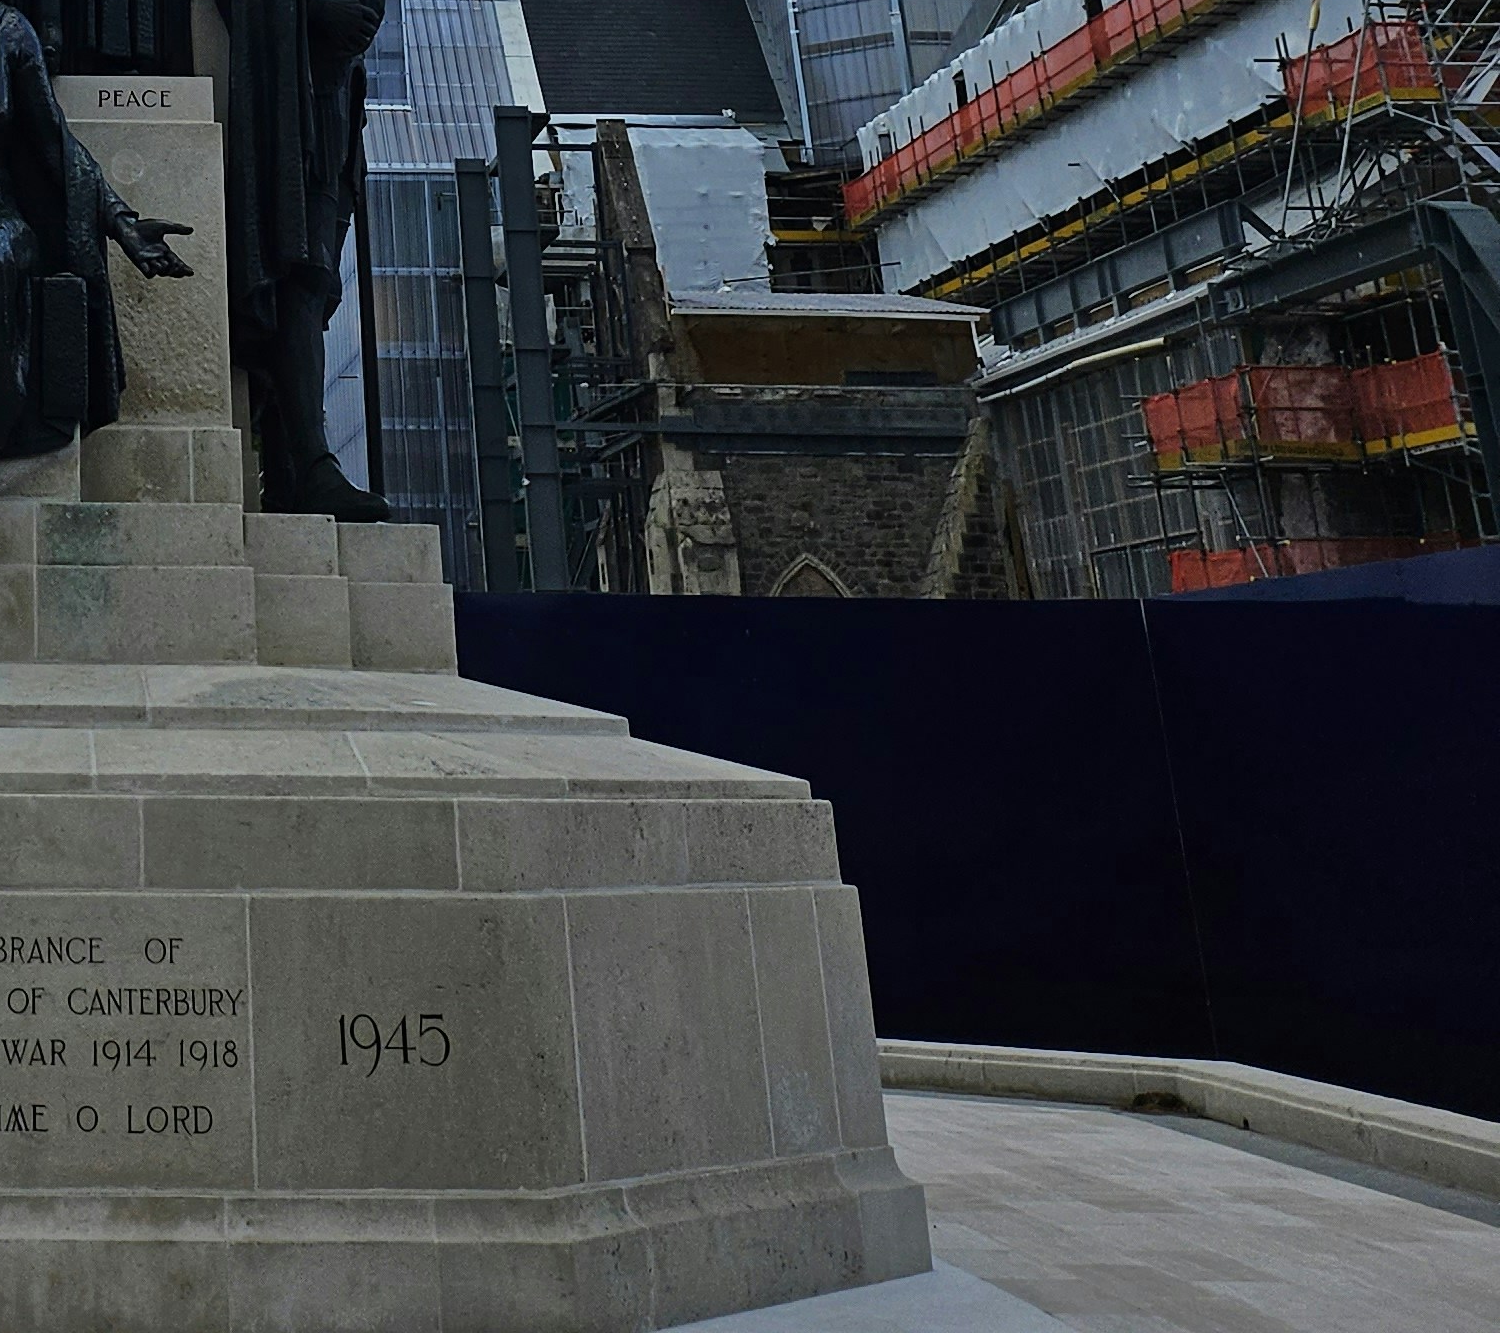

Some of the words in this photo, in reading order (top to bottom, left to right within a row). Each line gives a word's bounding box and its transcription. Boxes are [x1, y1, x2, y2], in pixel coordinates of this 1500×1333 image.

[97, 89, 172, 108] PEACE
[143, 936, 184, 965] OF
[6, 987, 45, 1015] OF
[67, 987, 244, 1017] CANTERBURY
[0, 1038, 67, 1067] WAR
[92, 1039, 157, 1072] 1914
[178, 1039, 240, 1072] 1918
[338, 1013, 451, 1079] 1945
[75, 1105, 100, 1133] O
[126, 1104, 214, 1136] LORD
